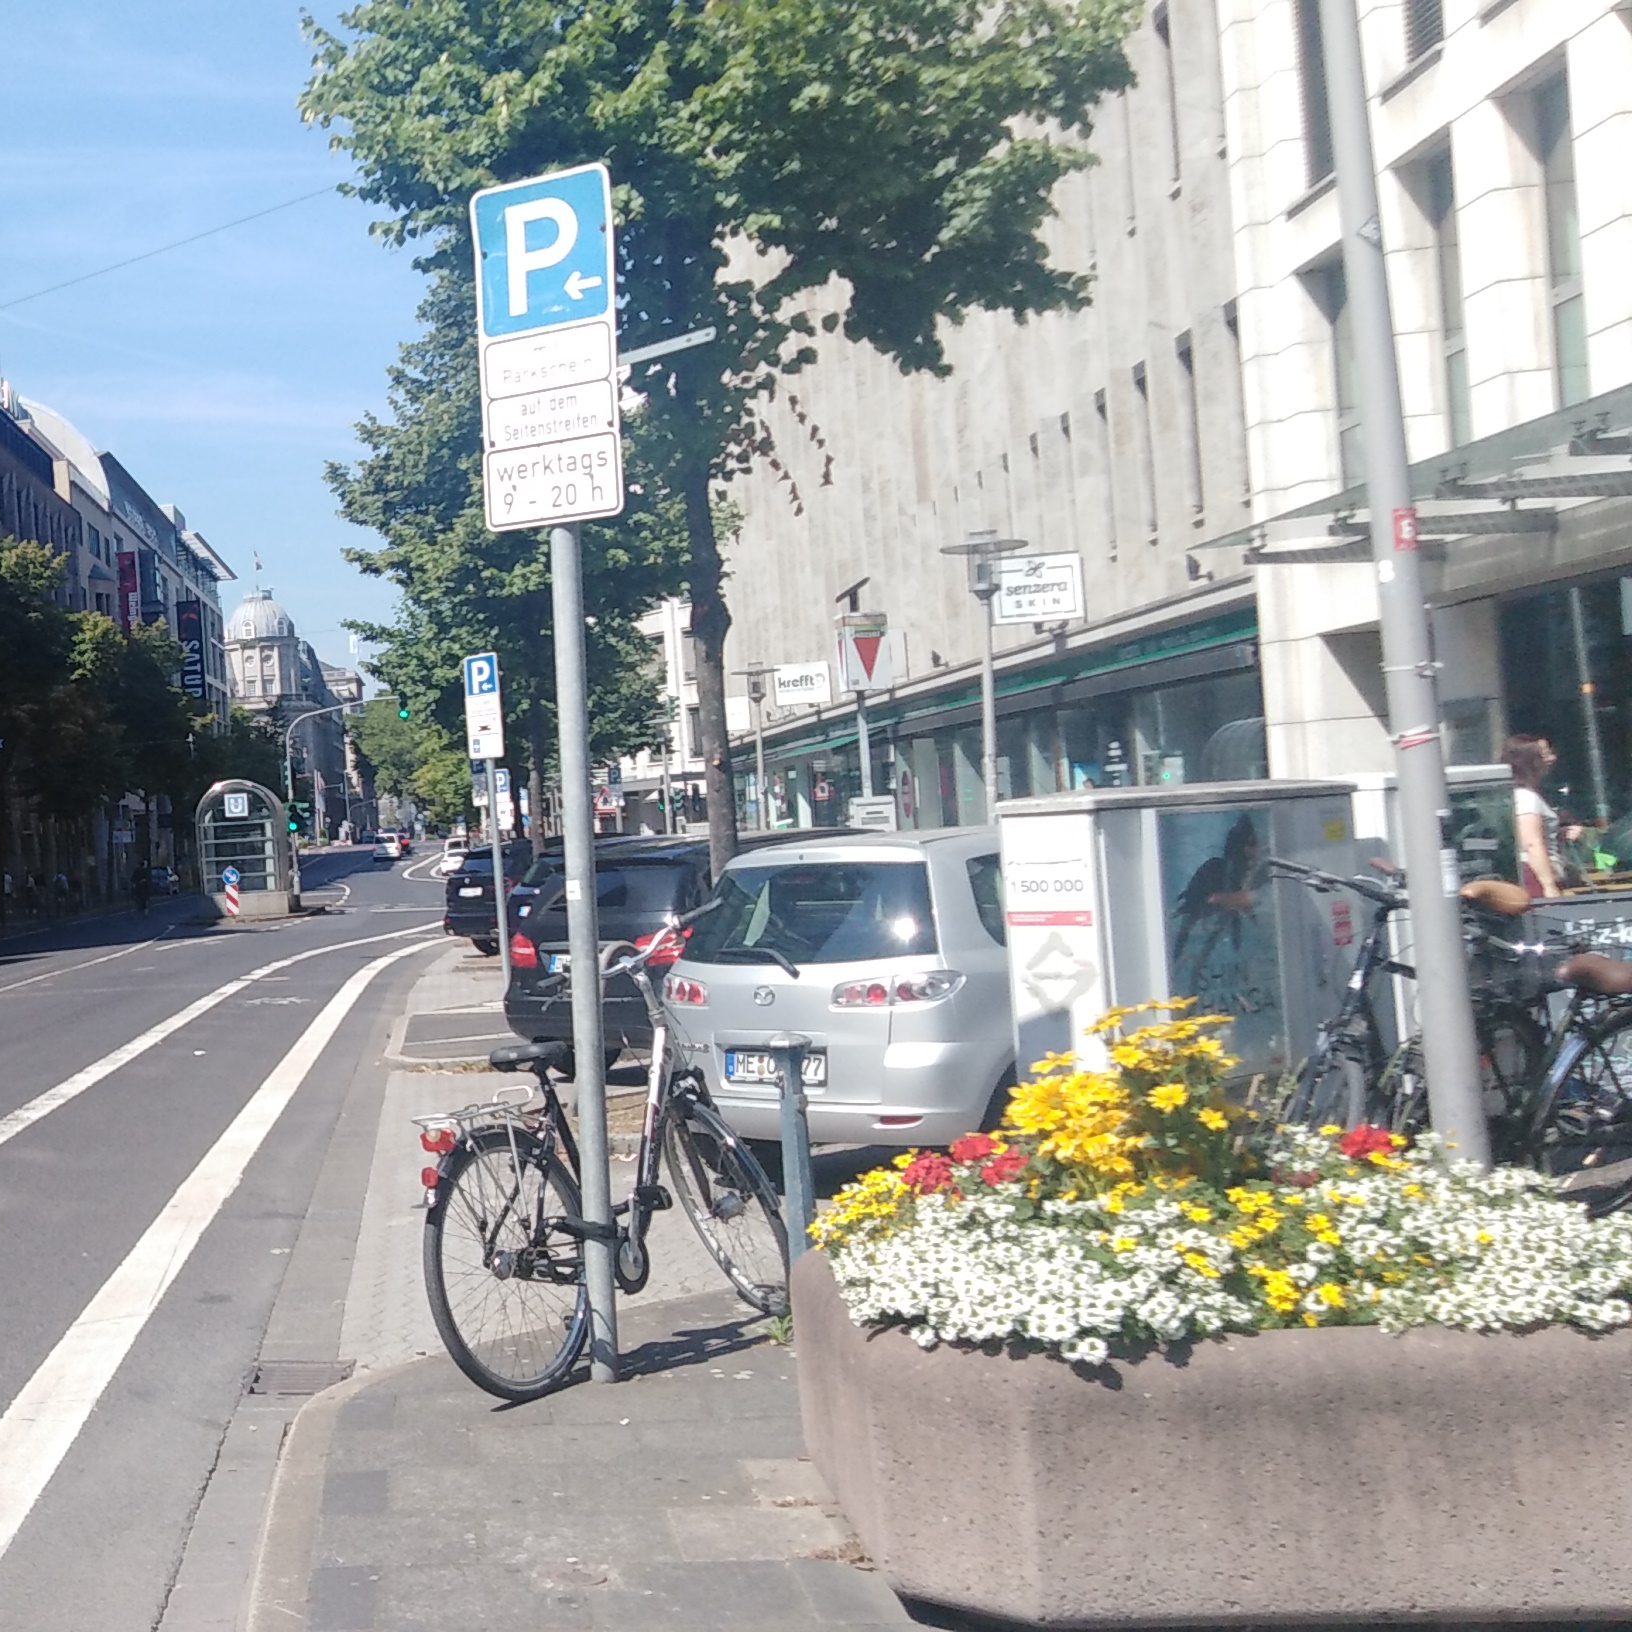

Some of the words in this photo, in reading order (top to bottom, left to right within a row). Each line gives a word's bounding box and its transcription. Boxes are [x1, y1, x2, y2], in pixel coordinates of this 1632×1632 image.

[504, 197, 578, 317] P
[503, 357, 592, 384] Parkschen
[521, 397, 541, 416] auf
[549, 395, 578, 411] dem
[504, 413, 597, 441] Seitenstreifen
[497, 450, 608, 482] werktags
[503, 492, 514, 514] 9
[551, 483, 577, 508] 20
[590, 475, 604, 502] h
[1006, 582, 1068, 597] senzera
[471, 660, 490, 694] P
[778, 674, 815, 689] krefft
[495, 772, 506, 792] P
[229, 798, 243, 813] U
[736, 1053, 756, 1074] ME
